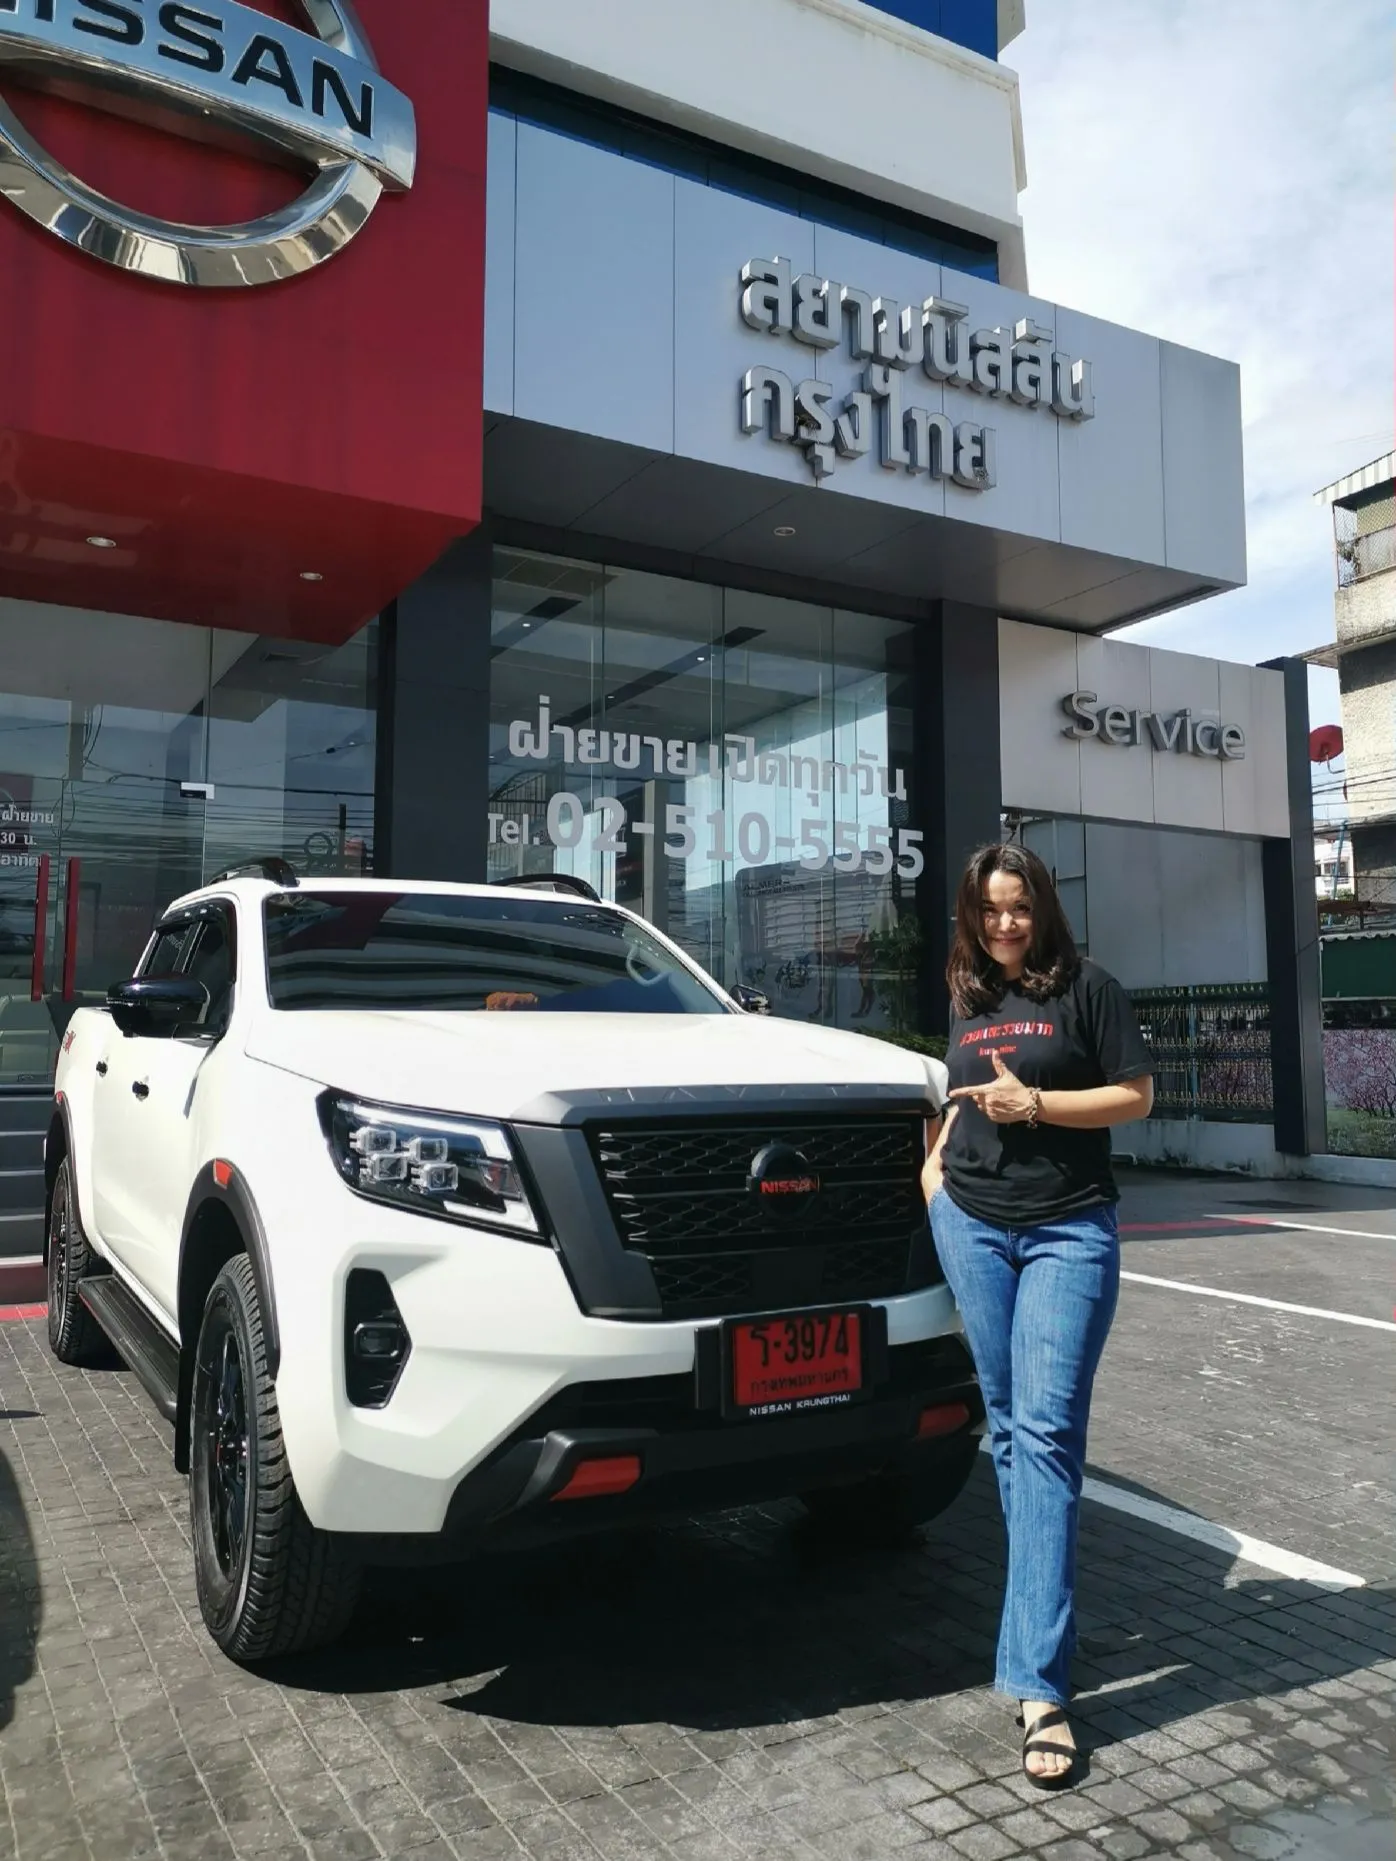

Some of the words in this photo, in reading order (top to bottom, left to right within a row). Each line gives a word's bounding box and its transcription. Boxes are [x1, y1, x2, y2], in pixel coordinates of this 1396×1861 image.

[0, 0, 375, 140] SSAN
[741, 256, 1095, 423] สยามนิสสัน
[741, 362, 997, 491] กรุงไทย
[508, 694, 697, 777] ฝ่ายขาย
[708, 732, 908, 808] เปิดทุกวัน
[1061, 689, 1246, 760] Service
[761, 1177, 817, 1194] NISSAN
[749, 1402, 792, 1416] NISSAN
[796, 1393, 851, 1409] KRUNGTHAI
